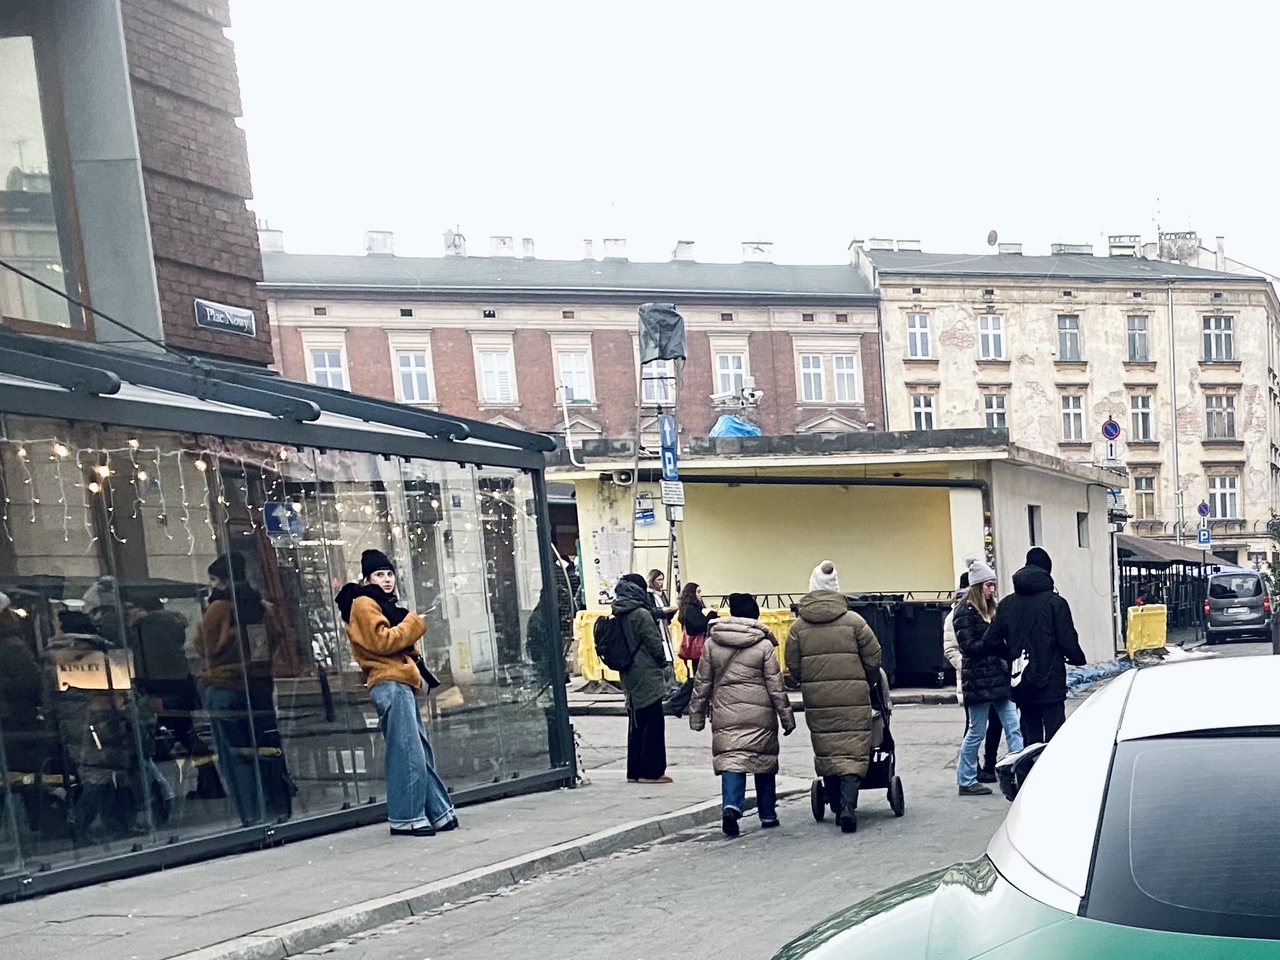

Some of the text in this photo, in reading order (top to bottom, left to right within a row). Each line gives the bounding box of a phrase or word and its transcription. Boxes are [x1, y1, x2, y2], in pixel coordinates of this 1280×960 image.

[205, 307, 249, 332] Plac Nowy
[664, 451, 674, 476] P
[1200, 531, 1208, 542] P
